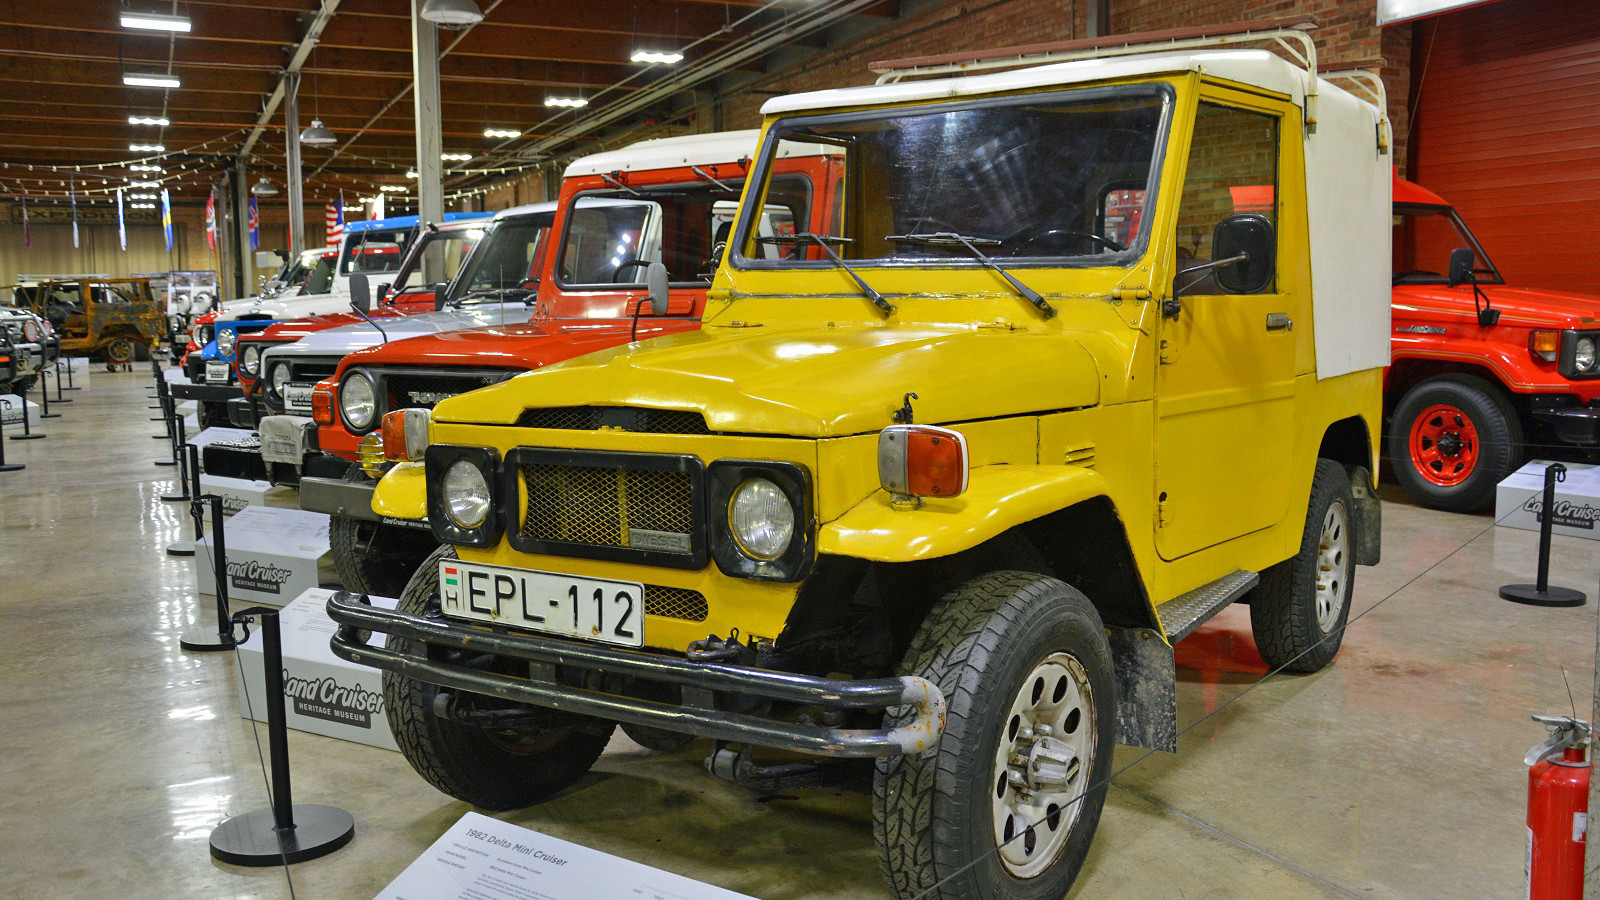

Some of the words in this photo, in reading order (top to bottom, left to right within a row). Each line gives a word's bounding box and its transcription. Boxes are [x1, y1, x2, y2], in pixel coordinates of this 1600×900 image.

[19, 210, 158, 220] EXPEDITON
[408, 391, 459, 404] TOY
[222, 493, 249, 510] Cruiser
[1523, 497, 1557, 514] La
[1556, 501, 1600, 521] Cruise
[633, 532, 687, 550] DIESEL
[225, 557, 248, 578] and
[247, 560, 292, 584] Cruiser
[235, 579, 256, 588] HERITAGE
[257, 581, 277, 591] MUSEUM
[469, 570, 635, 639] EPL-112
[319, 677, 384, 715] Cruiser
[299, 702, 331, 716] HERITAGE
[334, 709, 366, 722] MUSEUM
[465, 828, 488, 841] 1982
[487, 835, 512, 849] Delta
[511, 842, 535, 856] Mini
[533, 850, 568, 867] Cruiser
